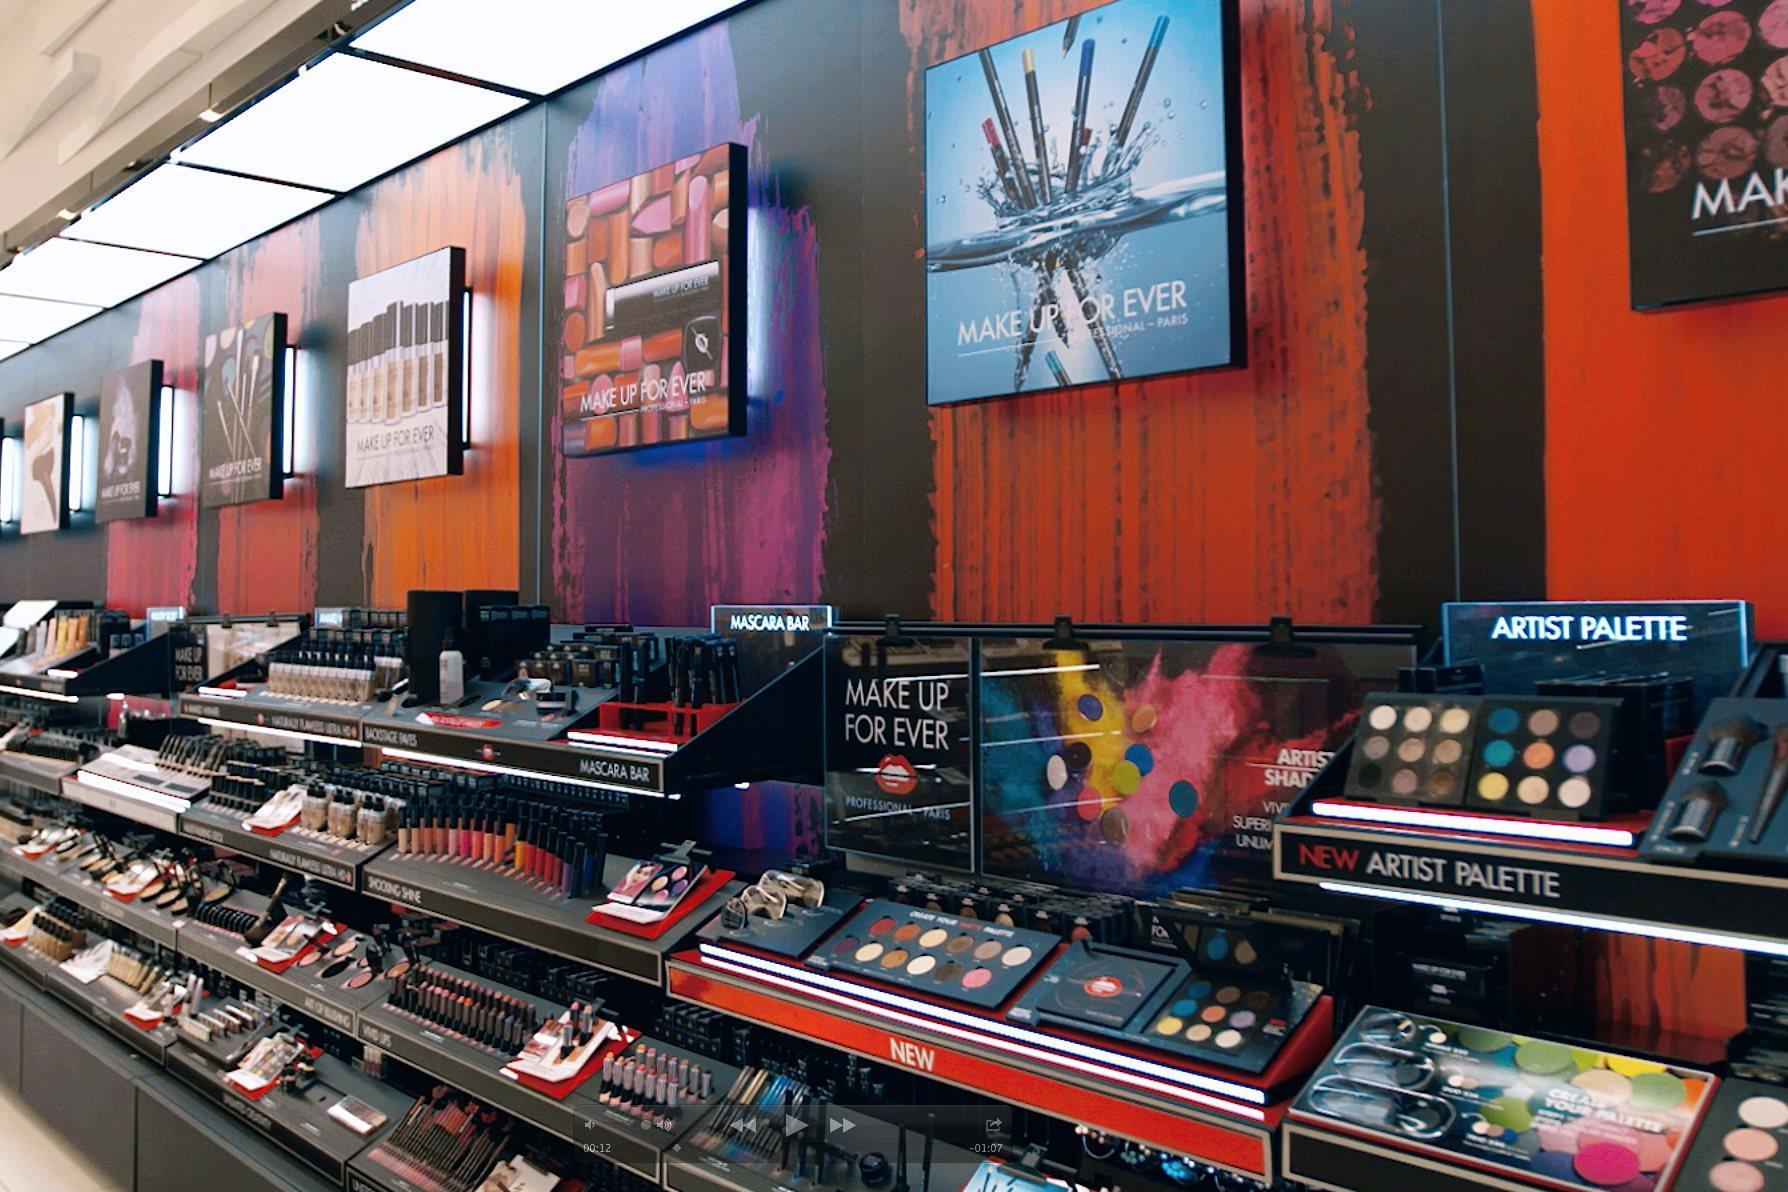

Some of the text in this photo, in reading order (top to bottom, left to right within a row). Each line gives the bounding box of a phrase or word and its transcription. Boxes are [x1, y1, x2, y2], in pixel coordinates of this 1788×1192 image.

[957, 280, 1188, 346] MAKE UP OR EVER
[1158, 313, 1188, 328] PARIS
[580, 371, 707, 413] MAKE UP FOR EVER
[356, 434, 379, 453] MAKE
[381, 431, 393, 450] UP
[394, 429, 411, 447] FOR
[413, 424, 435, 444] EVER
[730, 614, 810, 632] MASCARA BAR
[1491, 615, 1688, 641] ARTIST PALETTE
[845, 678, 950, 712] MAKE UP
[845, 713, 950, 750] FOR EVER
[580, 759, 650, 783] MASCARA BAR
[845, 795, 951, 821] PROFESSIONAL PARIS
[1299, 842, 1561, 899] NEW ARTIST PALETTE
[889, 1037, 935, 1073] NEW
